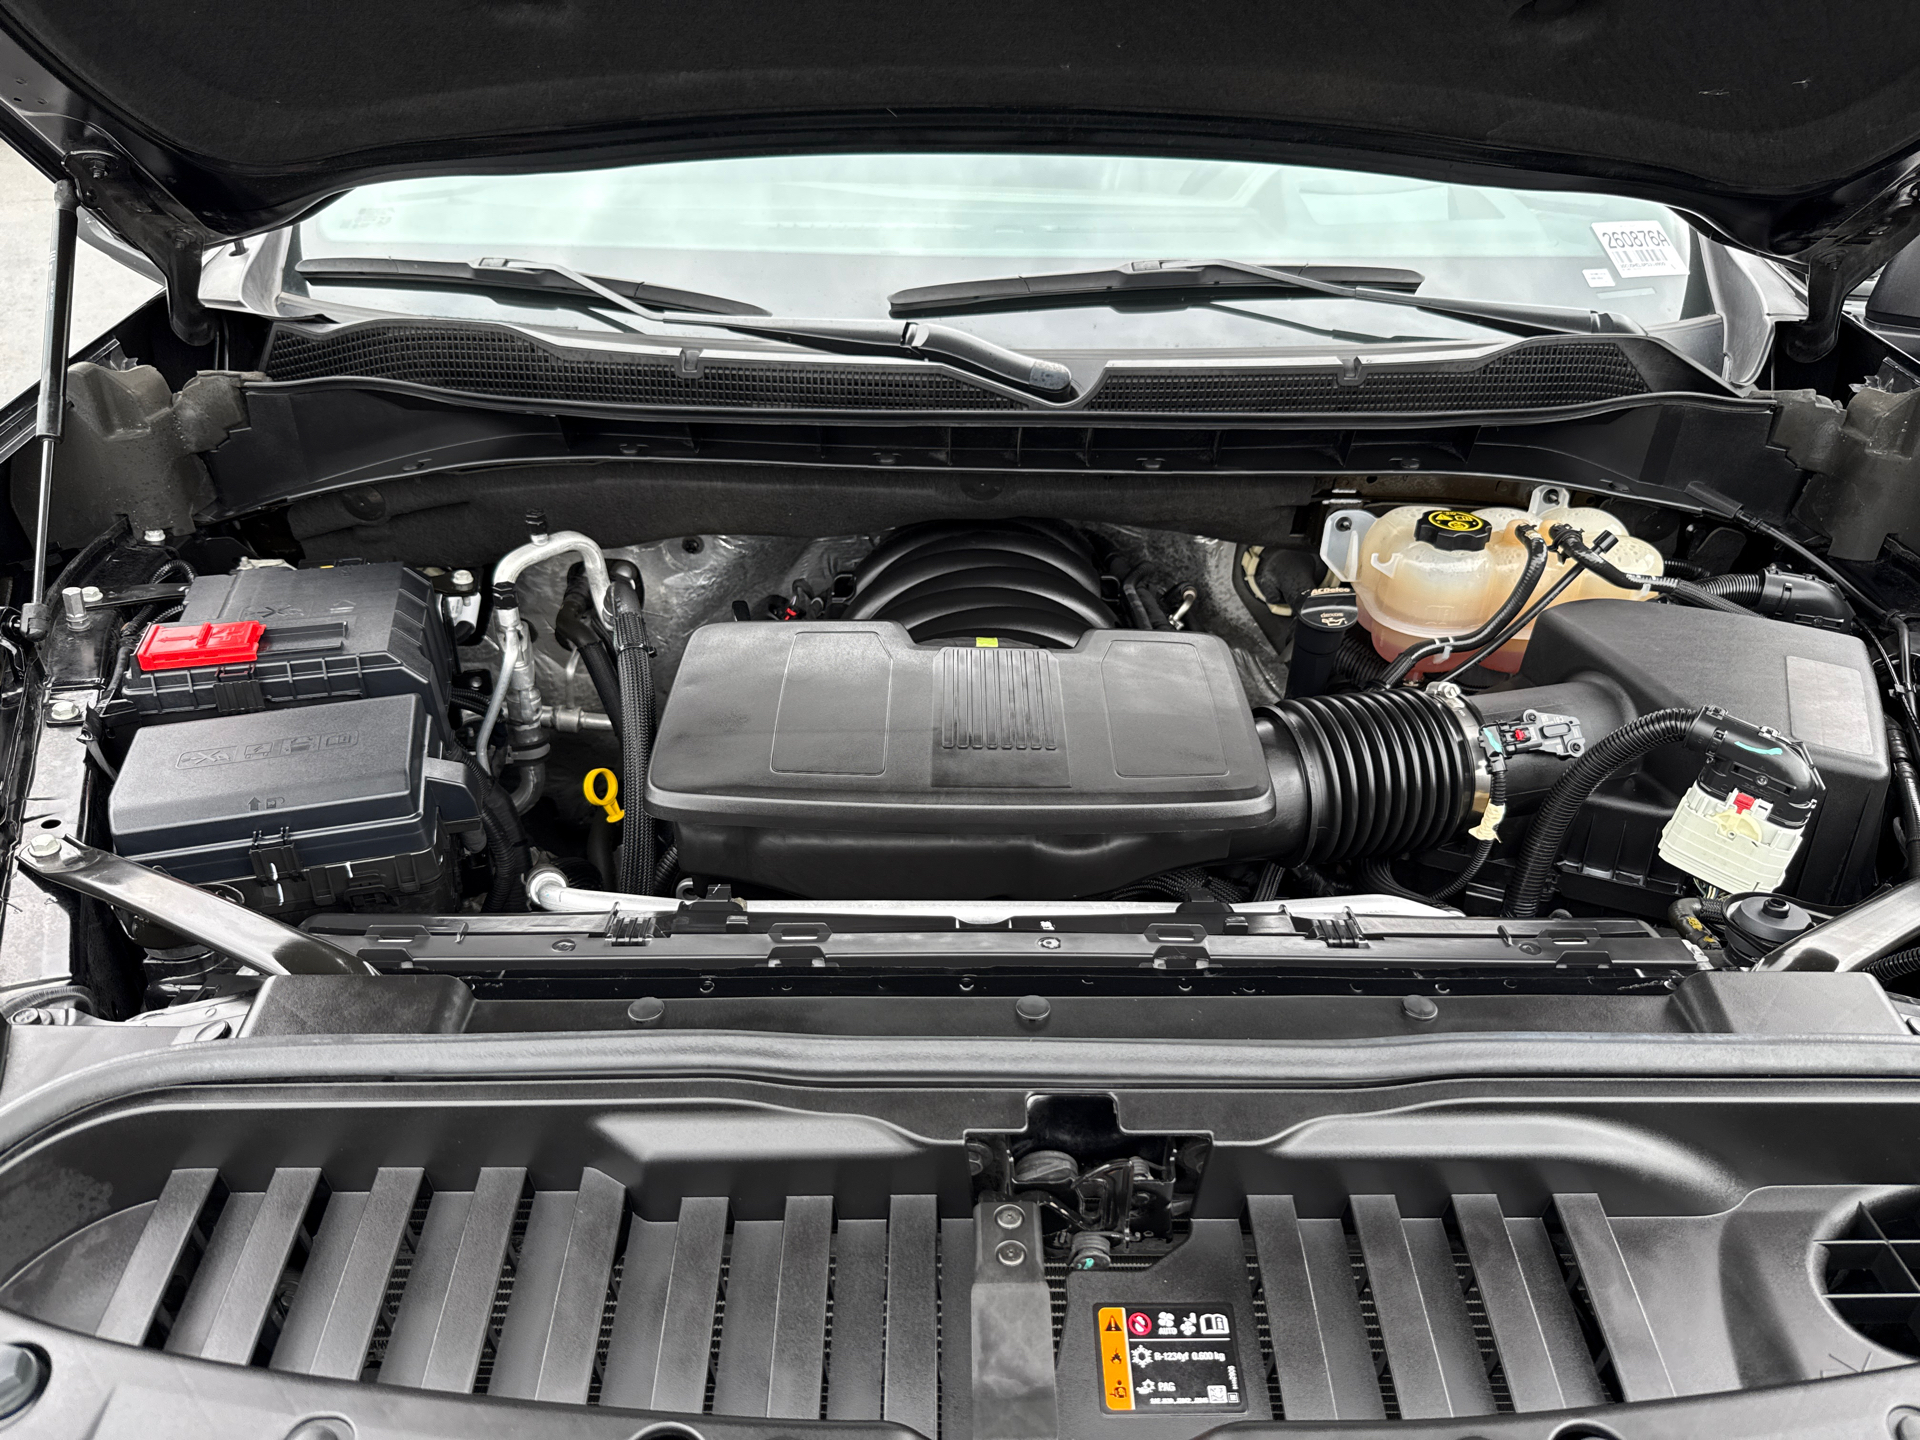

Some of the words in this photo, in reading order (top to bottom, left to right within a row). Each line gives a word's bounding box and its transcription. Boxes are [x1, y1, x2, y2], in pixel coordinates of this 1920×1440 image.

[1602, 229, 1671, 249] 260876A
[1310, 587, 1351, 596] ACDelco
[1214, 1352, 1226, 1362] kg
